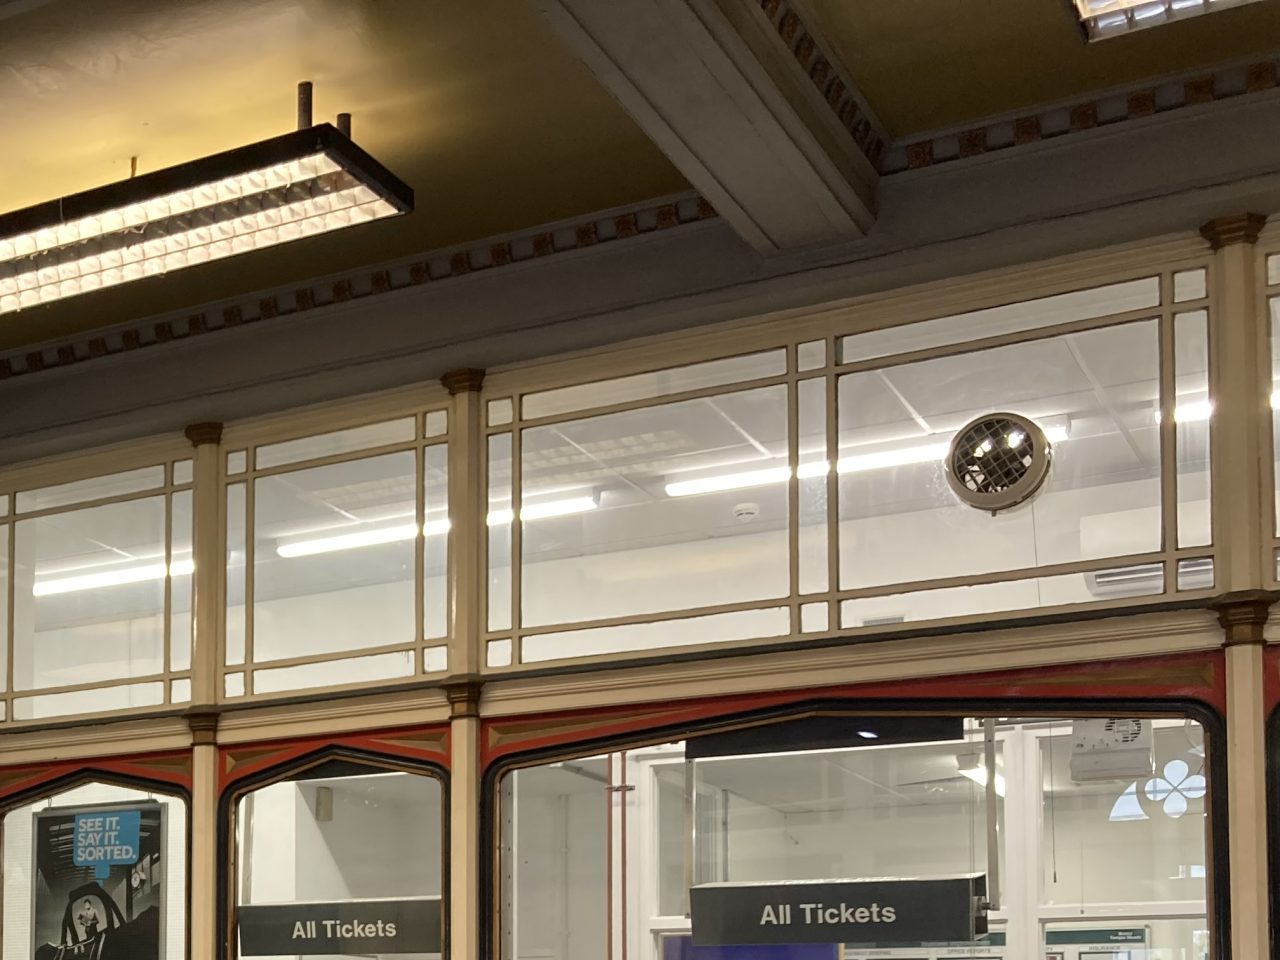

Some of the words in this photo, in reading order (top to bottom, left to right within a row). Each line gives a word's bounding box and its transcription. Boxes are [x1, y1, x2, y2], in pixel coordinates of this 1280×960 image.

[78, 817, 103, 832] SEE
[105, 816, 120, 831] IT.
[77, 832, 103, 847] SAY
[104, 831, 120, 845] IT.
[77, 845, 137, 861] SORTED.
[760, 904, 792, 925] All
[799, 902, 897, 924] Tickets
[291, 920, 317, 939] All
[322, 919, 397, 938] Tickets
